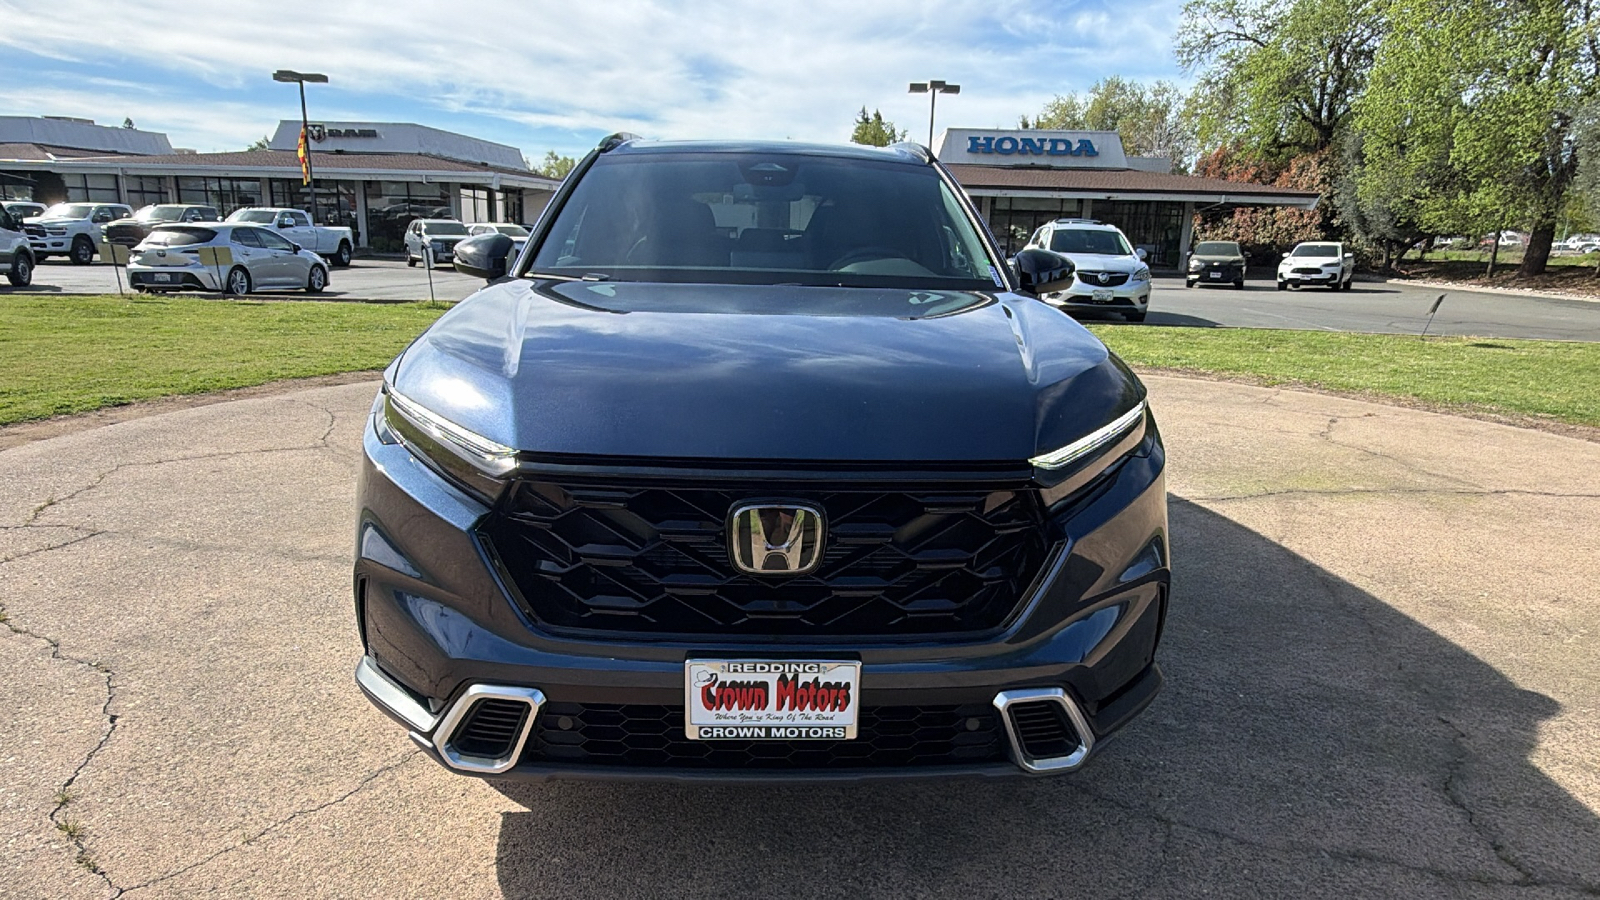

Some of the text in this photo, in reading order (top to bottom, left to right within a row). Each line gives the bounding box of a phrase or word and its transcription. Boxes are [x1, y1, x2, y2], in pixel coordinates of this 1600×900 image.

[967, 136, 1099, 157] HONDA
[729, 663, 819, 673] REDDING
[701, 673, 851, 713] Crown Motors
[714, 712, 738, 720] Where
[765, 713, 784, 722] King
[786, 713, 796, 722] Of
[798, 713, 812, 721] The
[815, 713, 835, 721] Road
[700, 727, 845, 738] CROWN MOTORS
